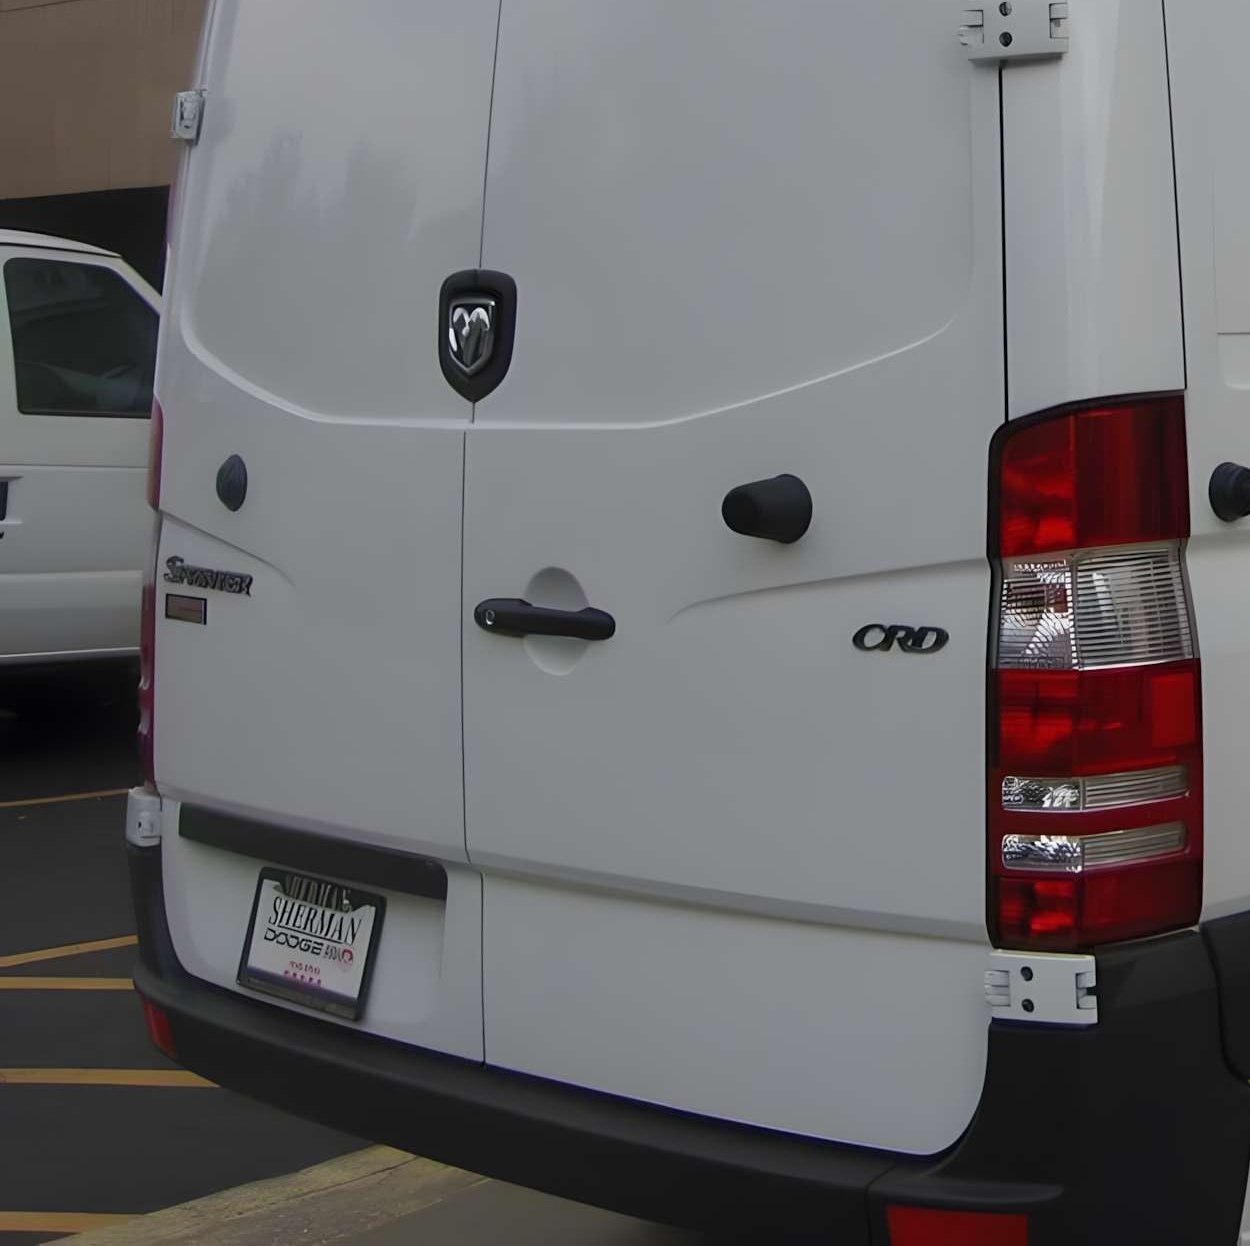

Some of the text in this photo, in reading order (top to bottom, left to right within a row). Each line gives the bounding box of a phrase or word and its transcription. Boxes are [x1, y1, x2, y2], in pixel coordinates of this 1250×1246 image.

[852, 623, 950, 655] CRD
[267, 896, 363, 946] SHERMAN
[263, 927, 325, 956] DODGE
